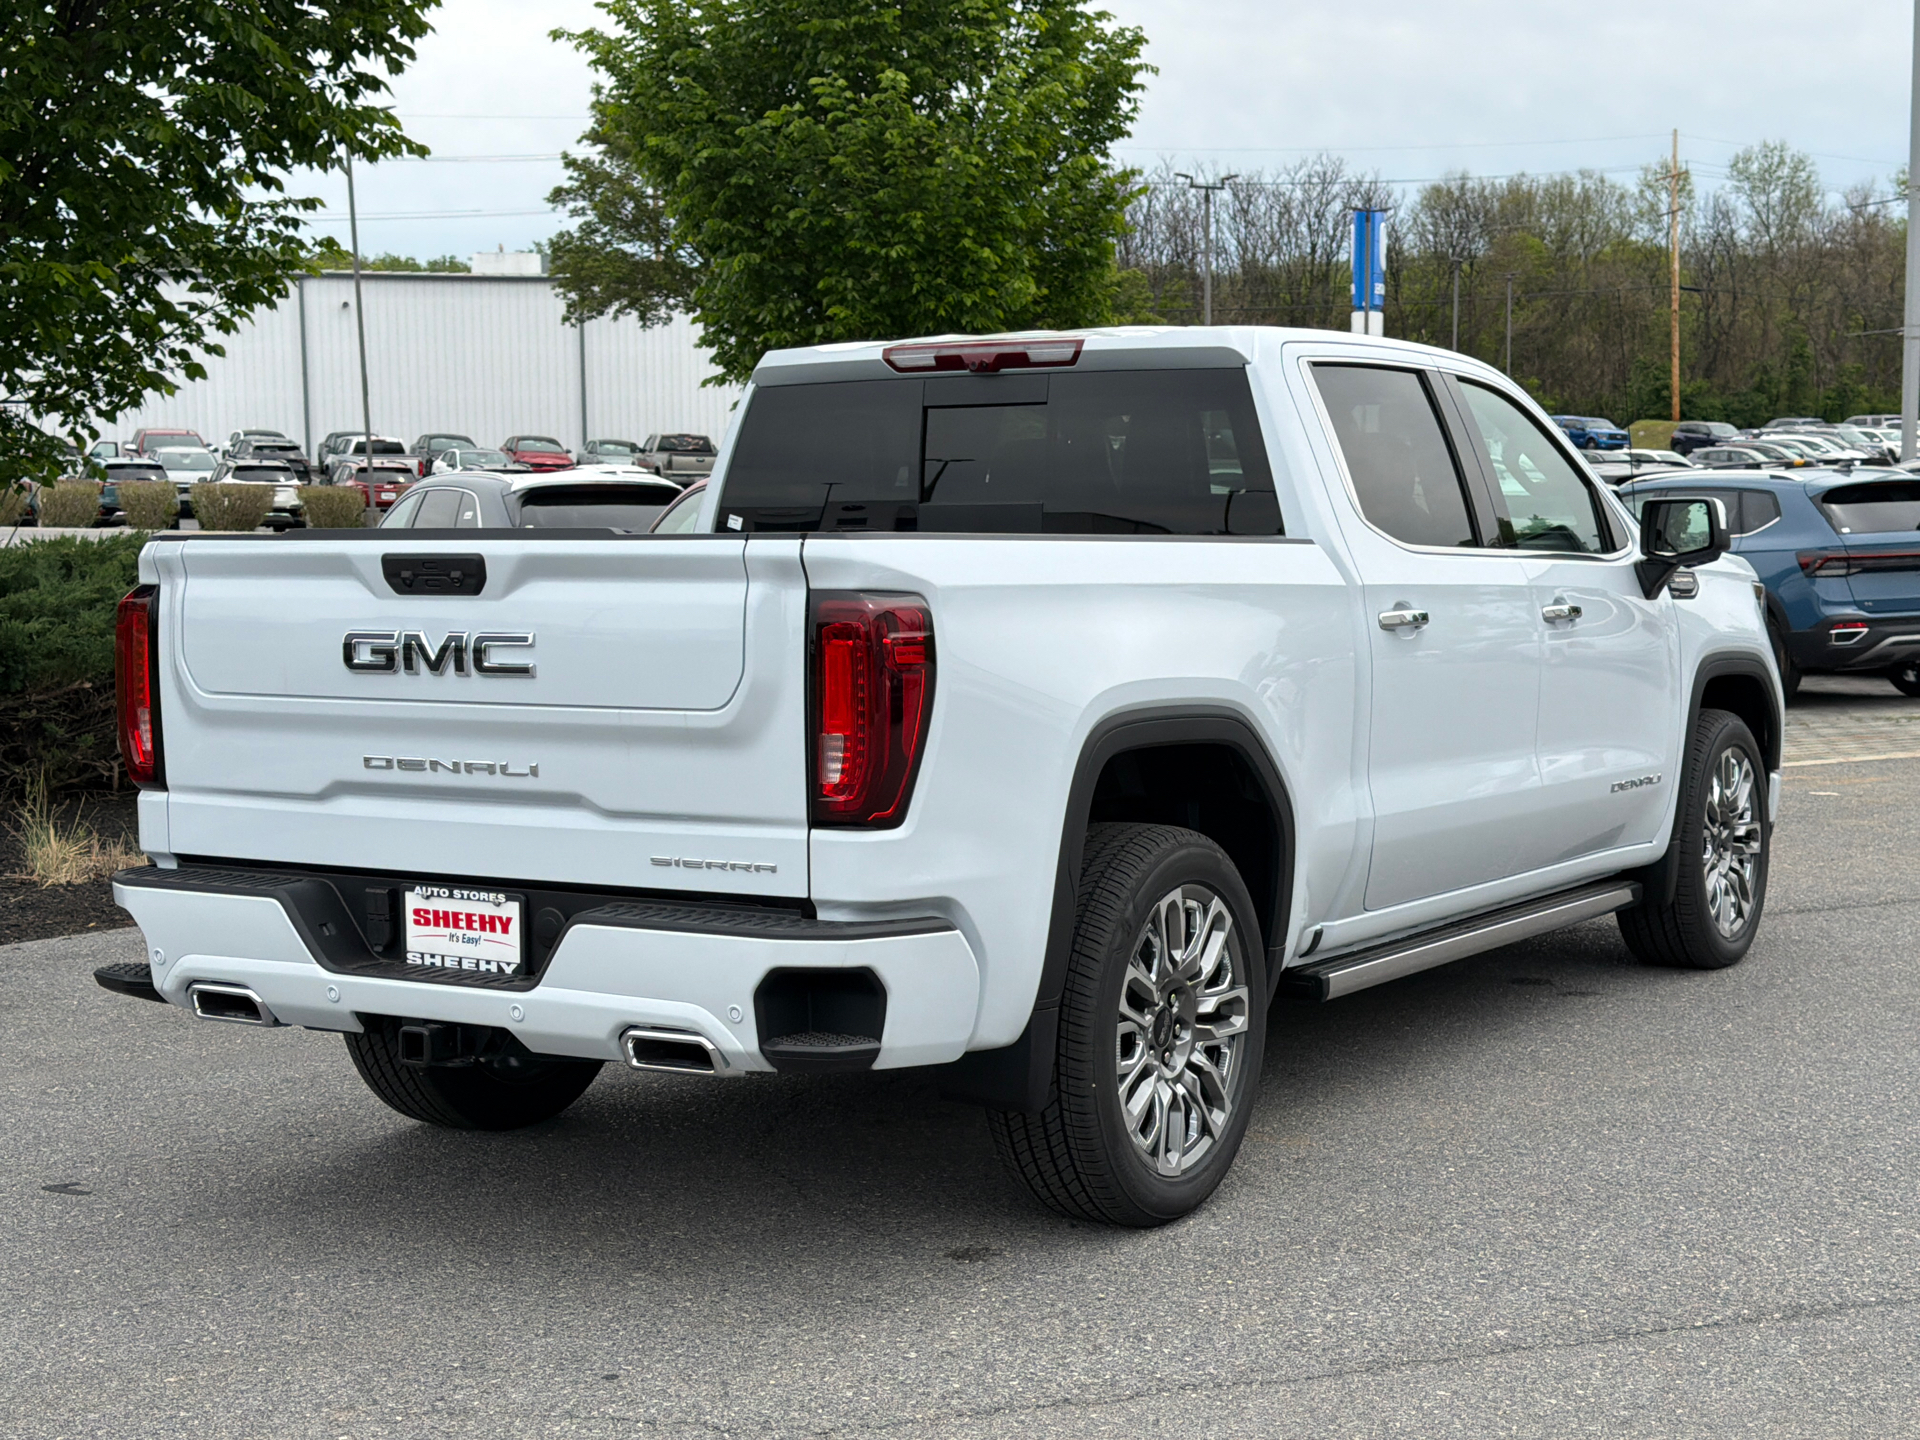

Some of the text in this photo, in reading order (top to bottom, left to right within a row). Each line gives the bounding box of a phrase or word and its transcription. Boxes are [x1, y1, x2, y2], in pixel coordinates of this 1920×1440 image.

[343, 630, 536, 678] GMC
[363, 755, 539, 778] DENALI
[1610, 773, 1661, 793] DENALI
[650, 856, 777, 873] SIERRA
[414, 886, 506, 903] AUTO STORES
[412, 908, 513, 935] SHEEHY
[449, 932, 481, 947] It's Easy!
[406, 952, 518, 975] SHEEHY
